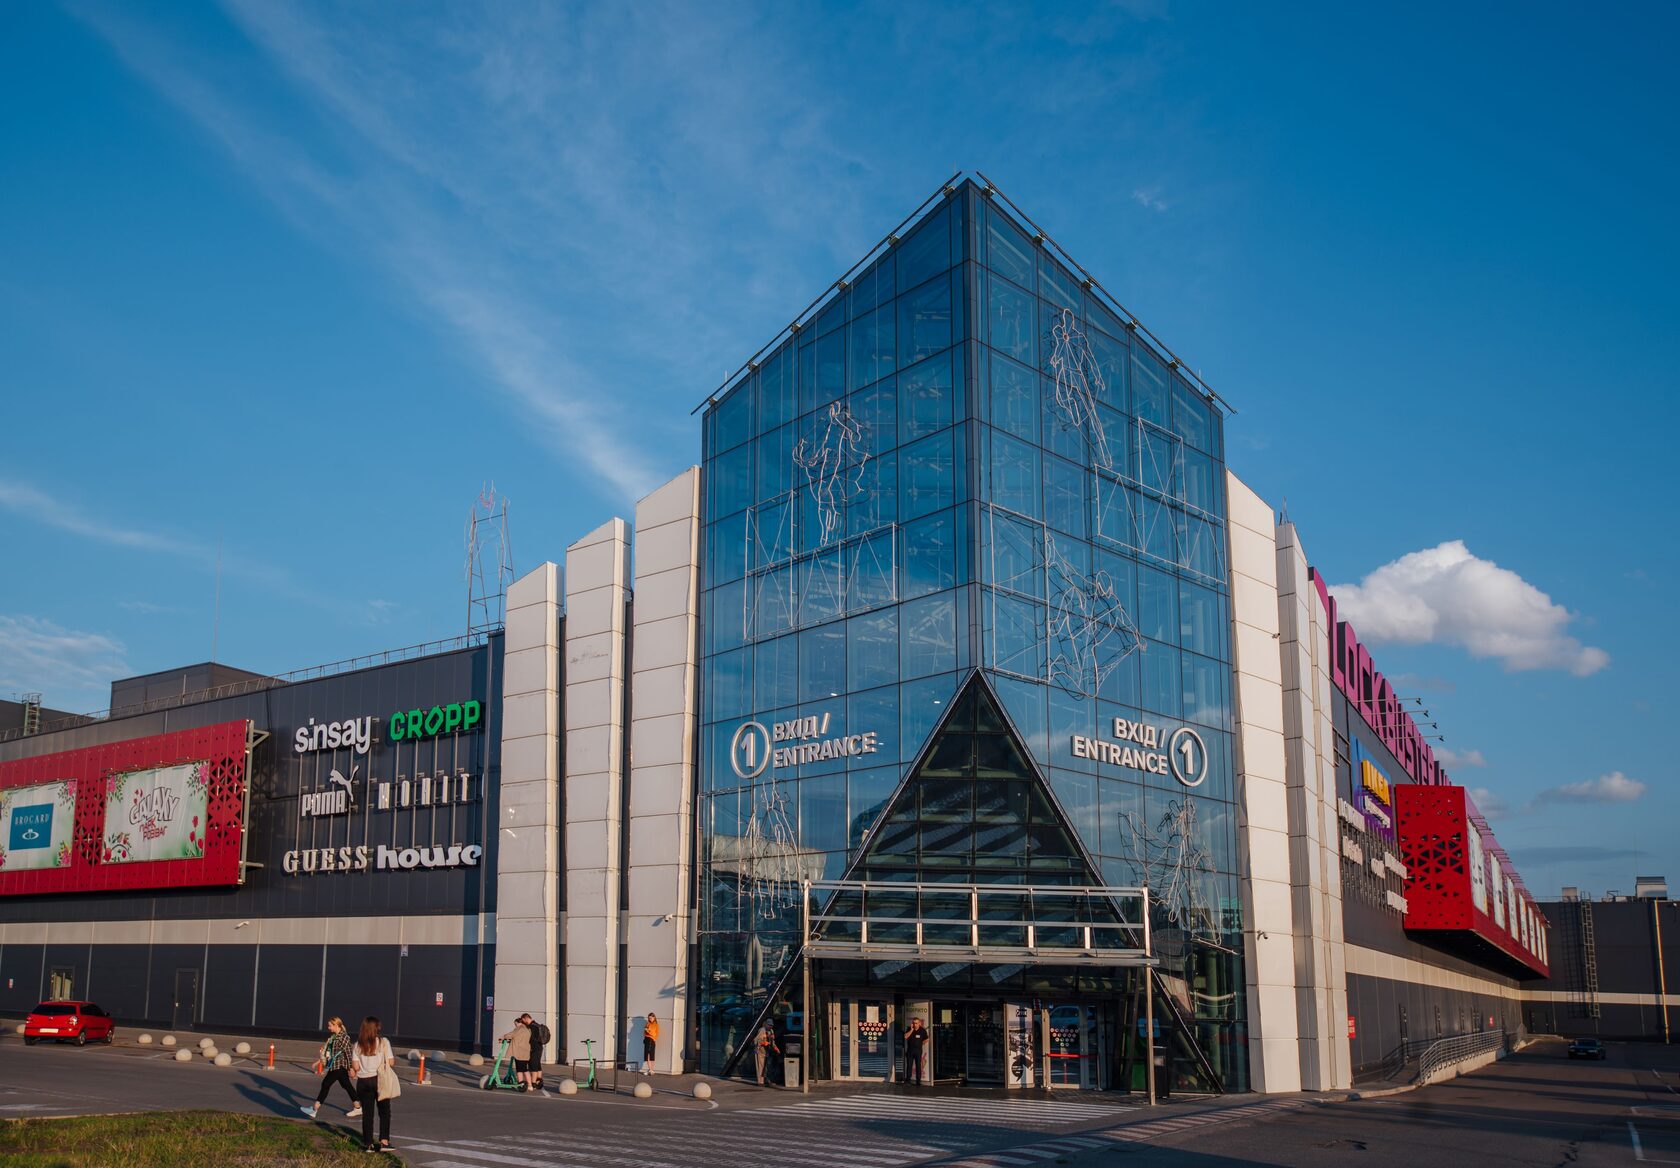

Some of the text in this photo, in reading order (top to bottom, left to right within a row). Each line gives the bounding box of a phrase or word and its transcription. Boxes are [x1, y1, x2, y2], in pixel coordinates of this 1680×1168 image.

[294, 717, 372, 754] sinsay
[389, 699, 481, 741] CROPP
[740, 732, 755, 767] 1
[773, 731, 877, 769] ENTRANCE
[1071, 735, 1168, 775] ENTRANCE
[1179, 739, 1194, 775] 1
[14, 813, 49, 825] BROCARD
[129, 786, 180, 825] GALAXY
[301, 790, 348, 817] PUMA
[283, 845, 368, 873] GUESS
[377, 844, 482, 870] house
